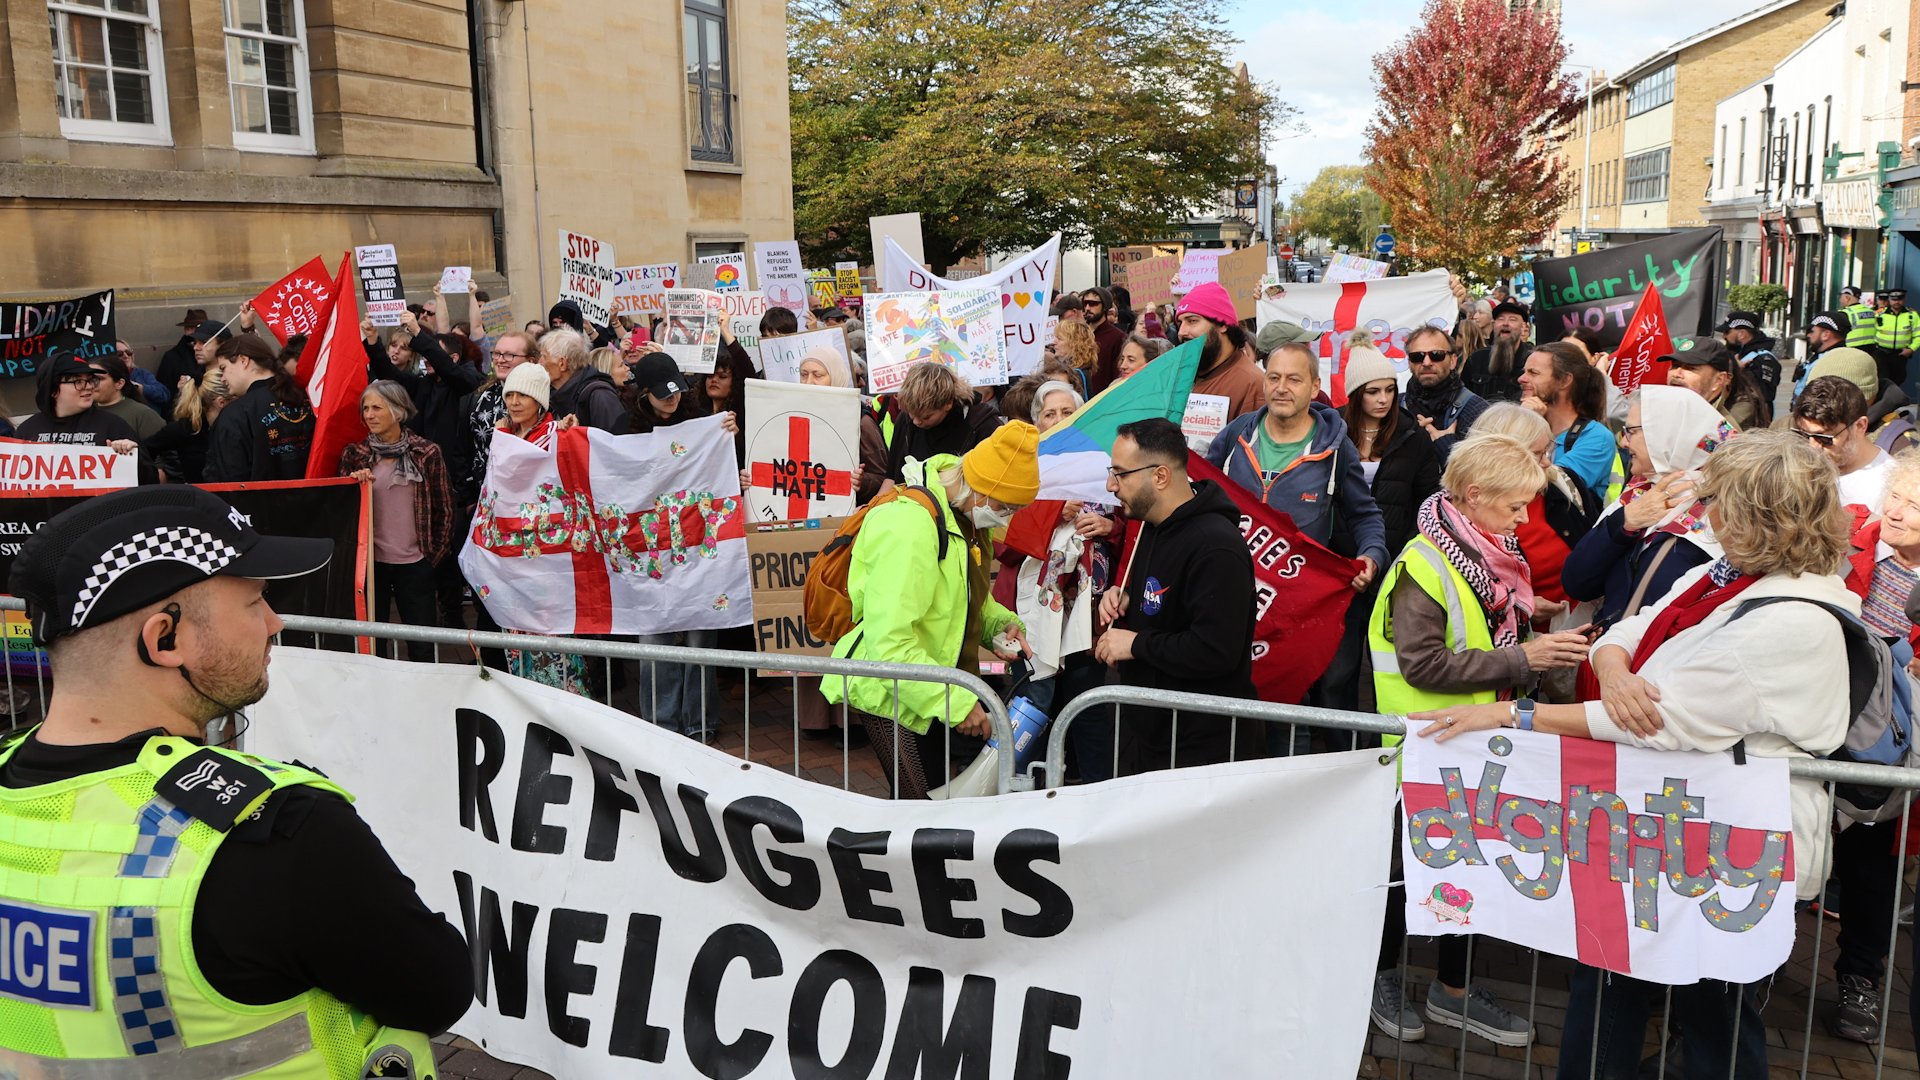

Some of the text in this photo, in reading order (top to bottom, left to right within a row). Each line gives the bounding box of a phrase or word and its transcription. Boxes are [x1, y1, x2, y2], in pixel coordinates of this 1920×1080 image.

[567, 233, 600, 263] STOP
[1112, 252, 1142, 263] NO TO
[702, 255, 743, 265] MIGRATION
[1128, 257, 1178, 278] SEEKING
[374, 267, 396, 278] HOMES
[598, 265, 613, 282] YOUR
[614, 265, 677, 286] DIVERSITY
[369, 278, 396, 290] SERVICES
[569, 273, 601, 300] RACISM
[1130, 276, 1164, 292] SAFETY
[369, 289, 394, 300] FOR ALL!
[668, 293, 697, 302] COMMUNIST
[946, 290, 998, 317] SOLIDARITY
[304, 300, 318, 328] unite
[383, 301, 405, 311] RACISM
[1562, 301, 1635, 332] NOT
[733, 321, 752, 334] for
[971, 321, 993, 338] HATE
[5, 334, 47, 359] NOT
[980, 377, 997, 385] NOT
[0, 454, 117, 480] TIONARY
[773, 459, 827, 478] NO TO
[773, 475, 826, 501] HATE
[206, 776, 228, 792] W
[216, 780, 247, 805] 361
[455, 708, 1074, 938] REFUGEES
[1408, 735, 1792, 932] dignity
[453, 869, 1082, 1080] WELCOME
